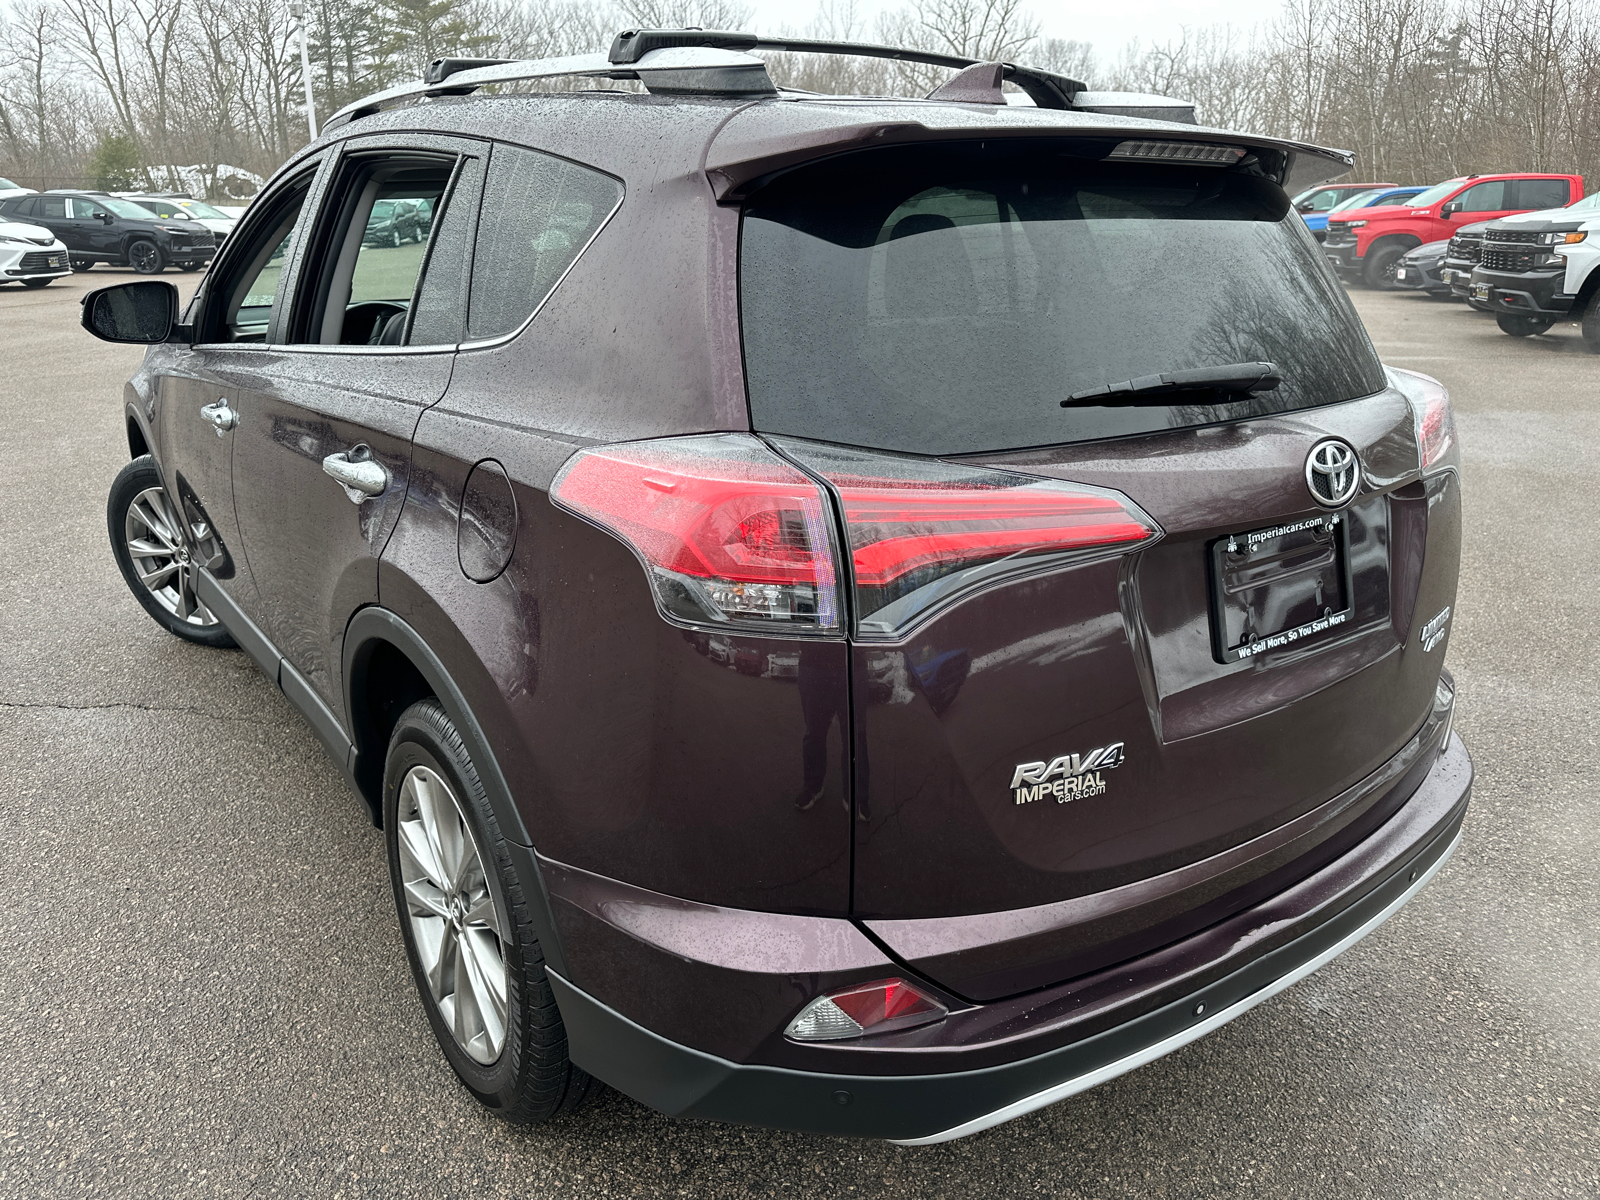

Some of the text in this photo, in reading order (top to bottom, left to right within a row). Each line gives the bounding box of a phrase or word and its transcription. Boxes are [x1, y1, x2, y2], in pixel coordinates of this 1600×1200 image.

[1247, 517, 1323, 544] Imperialcars.com
[1238, 613, 1346, 659] We Sell More, So You Save More
[1009, 741, 1126, 790] RAV4
[1013, 770, 1107, 806] IMPERIAL
[1056, 784, 1107, 805] cars.com
